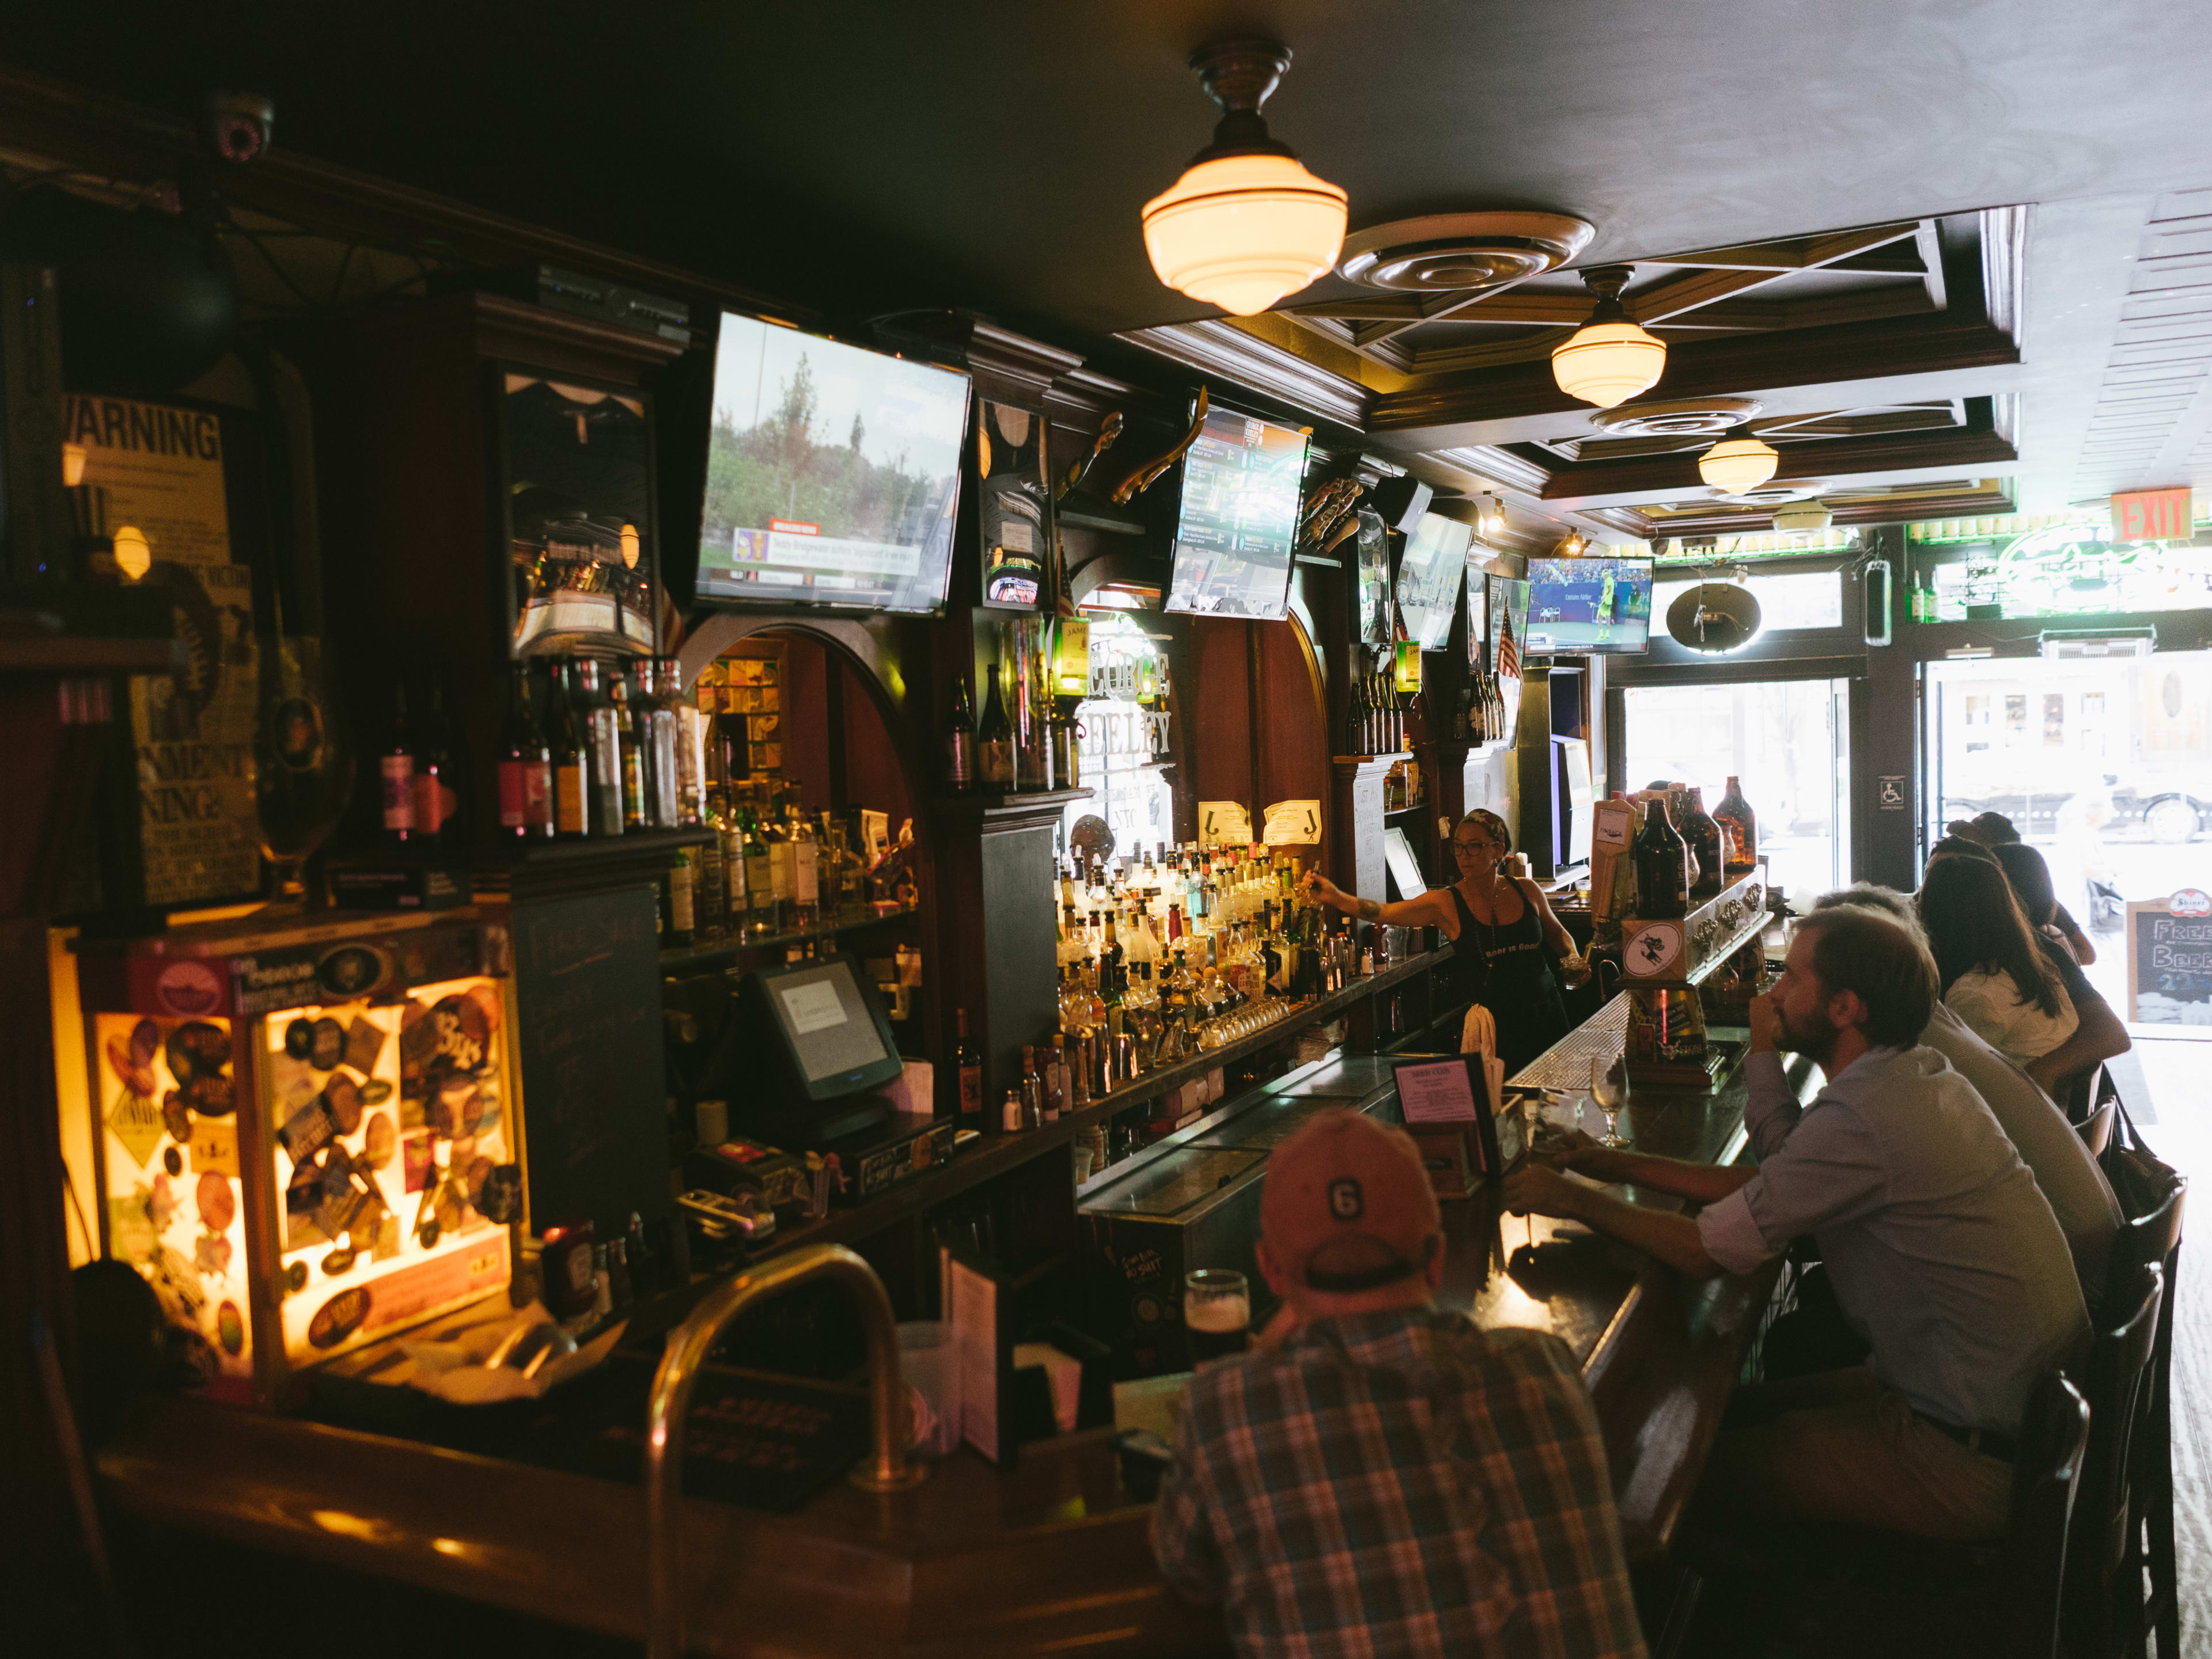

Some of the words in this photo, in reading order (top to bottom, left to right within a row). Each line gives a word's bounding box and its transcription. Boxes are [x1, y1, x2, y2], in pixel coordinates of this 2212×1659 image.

[2122, 493, 2185, 540] EXIT
[1088, 651, 1170, 696] EORGE
[2177, 898, 2205, 907] Shiner
[2154, 920, 2212, 940] FREE
[1329, 1177, 1363, 1220] 6
